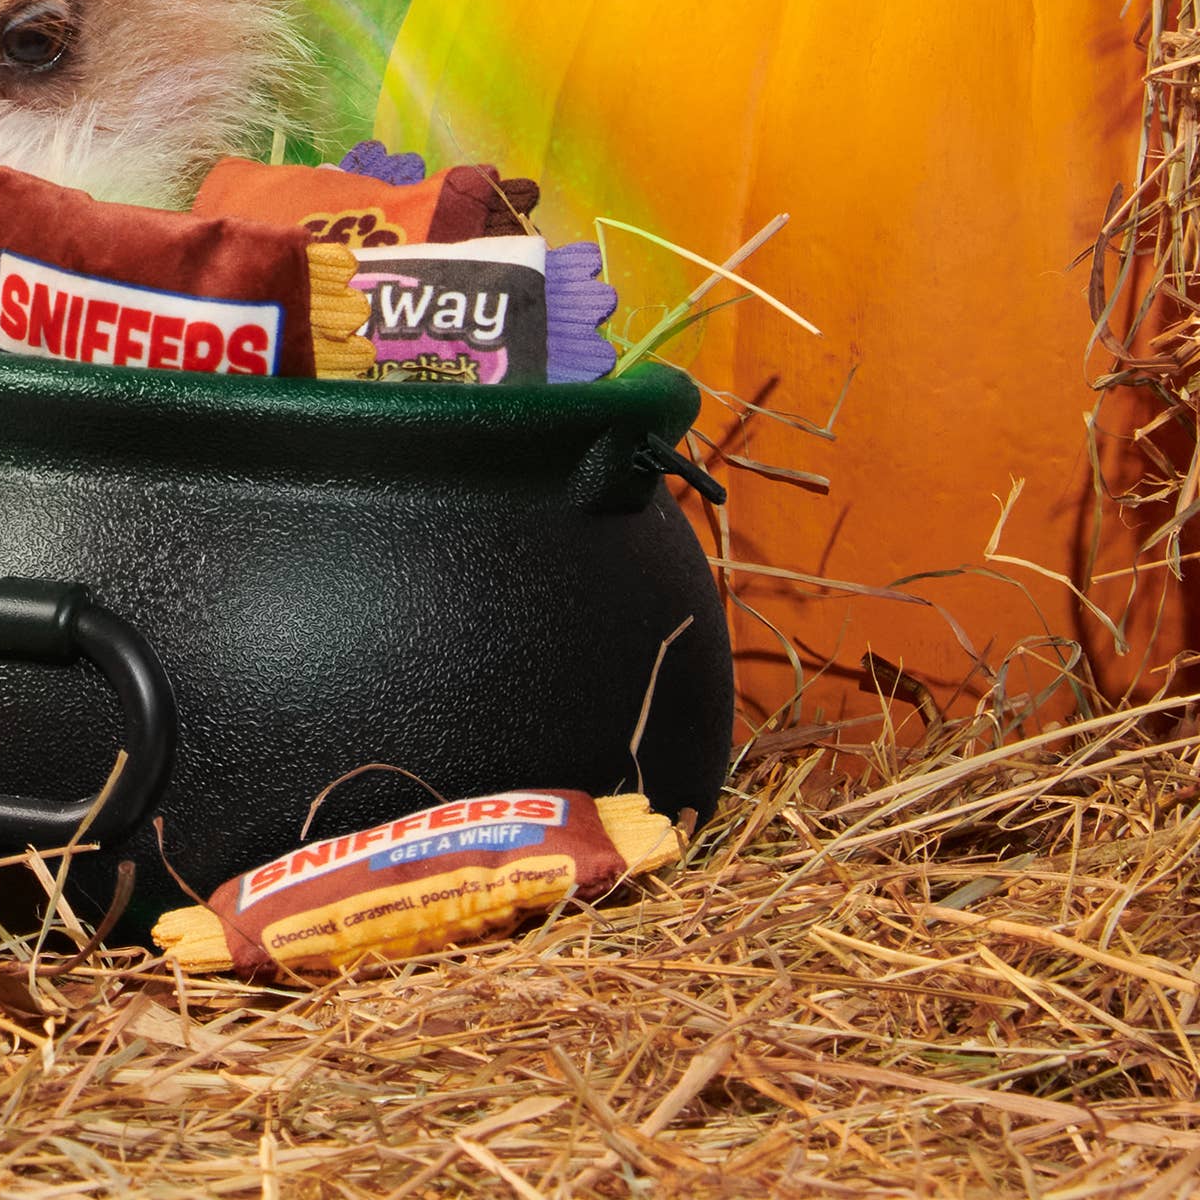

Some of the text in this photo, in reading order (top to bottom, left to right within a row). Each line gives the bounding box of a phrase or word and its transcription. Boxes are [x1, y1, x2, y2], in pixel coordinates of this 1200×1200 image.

[0, 273, 269, 376] SNIFFERS
[248, 799, 556, 895] SNIFFERS
[389, 824, 523, 863] GET A WHIFF
